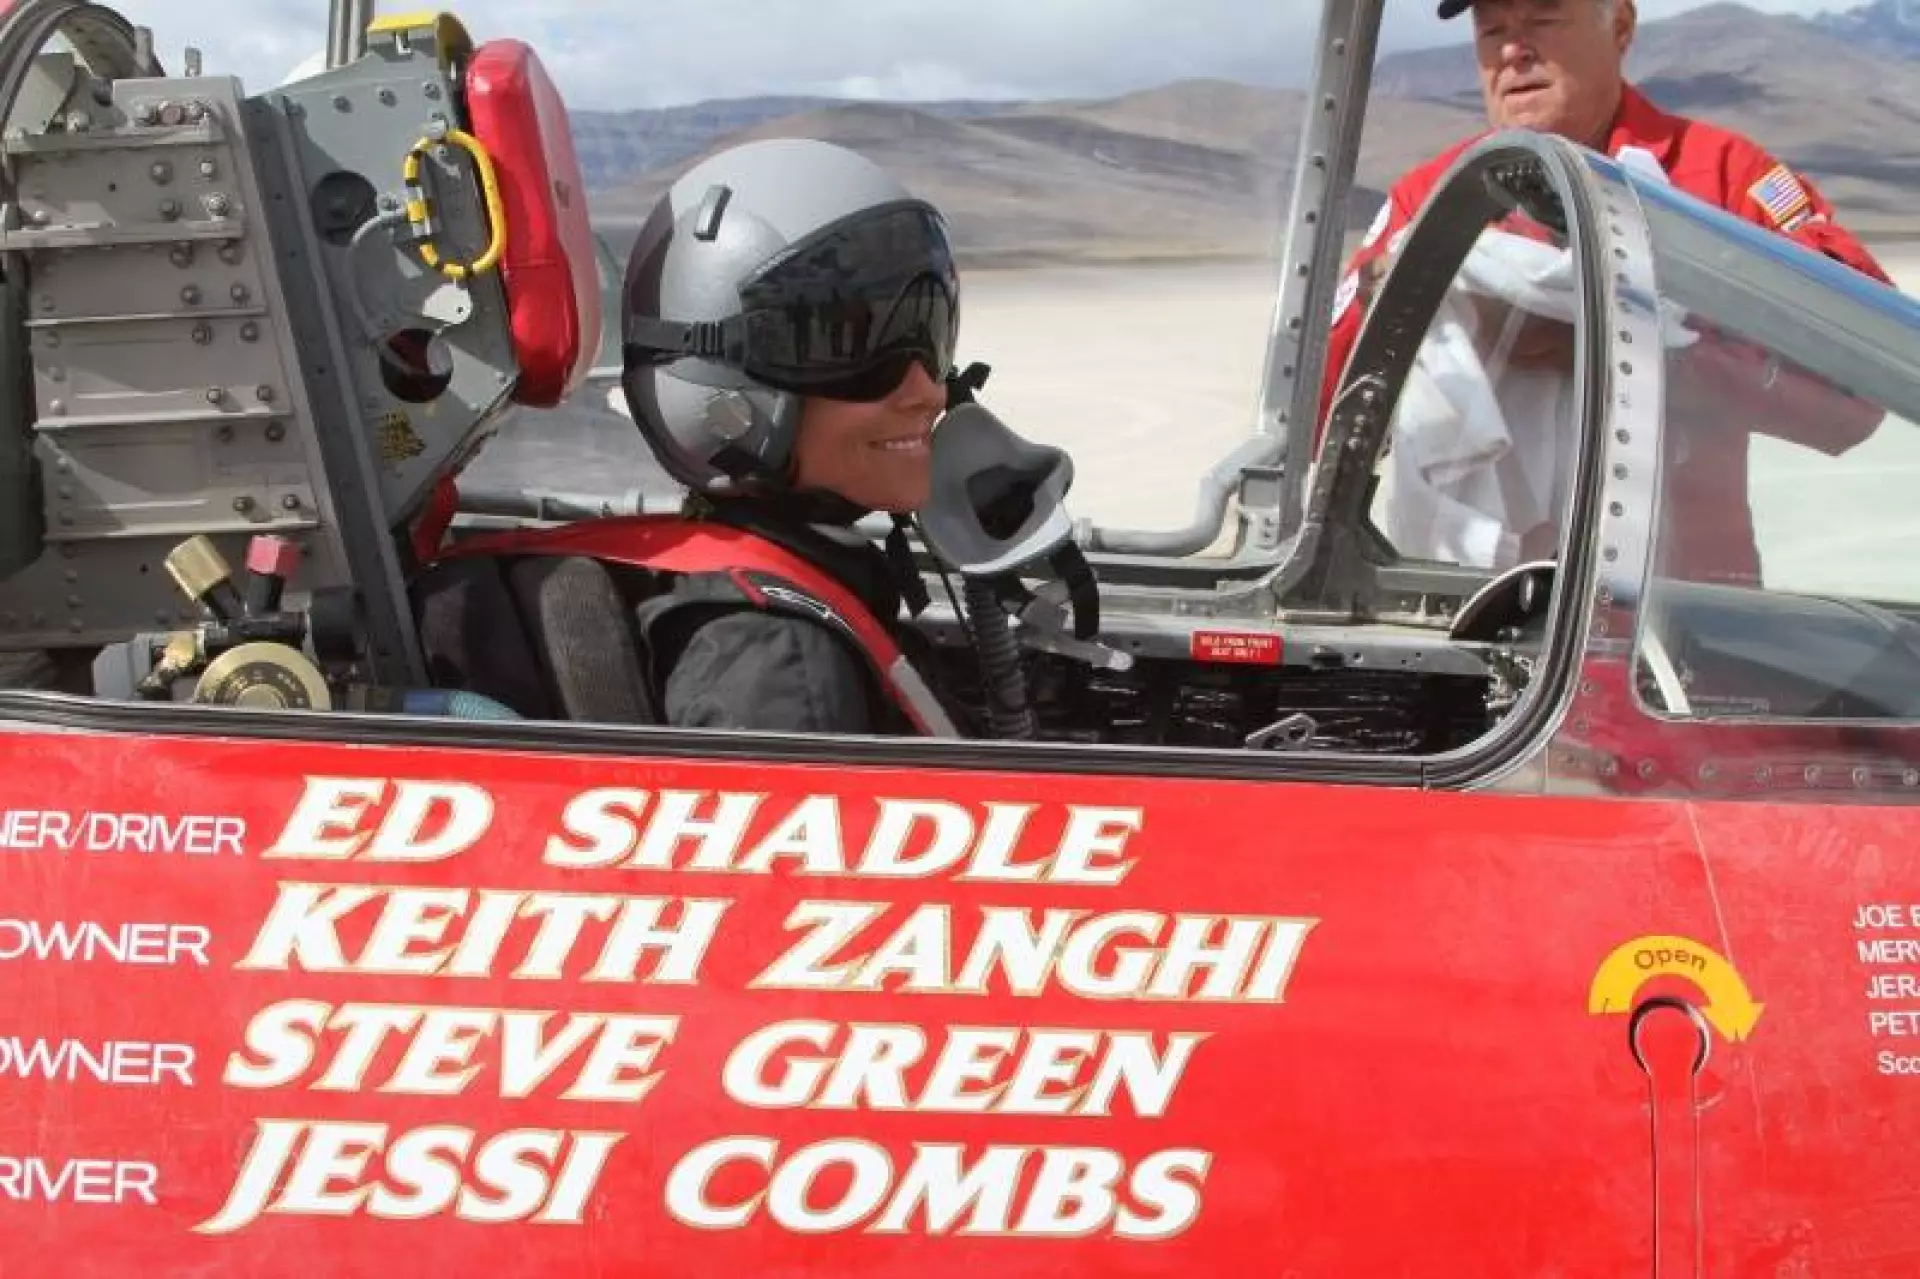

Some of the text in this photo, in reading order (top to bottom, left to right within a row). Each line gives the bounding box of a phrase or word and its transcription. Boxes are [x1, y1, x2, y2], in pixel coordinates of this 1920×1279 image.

[261, 774, 495, 862] ED
[543, 788, 1144, 885] SHADLE
[233, 880, 735, 986] KEITH
[746, 899, 1321, 1004] ZANGHI
[1633, 949, 1707, 971] Open
[1853, 904, 1907, 929] JOE
[1865, 975, 1920, 999] JER
[222, 999, 681, 1104] STEVE
[722, 1019, 1216, 1118] GREEN
[190, 1117, 627, 1235] JESSI
[664, 1134, 1213, 1242] COMBS
